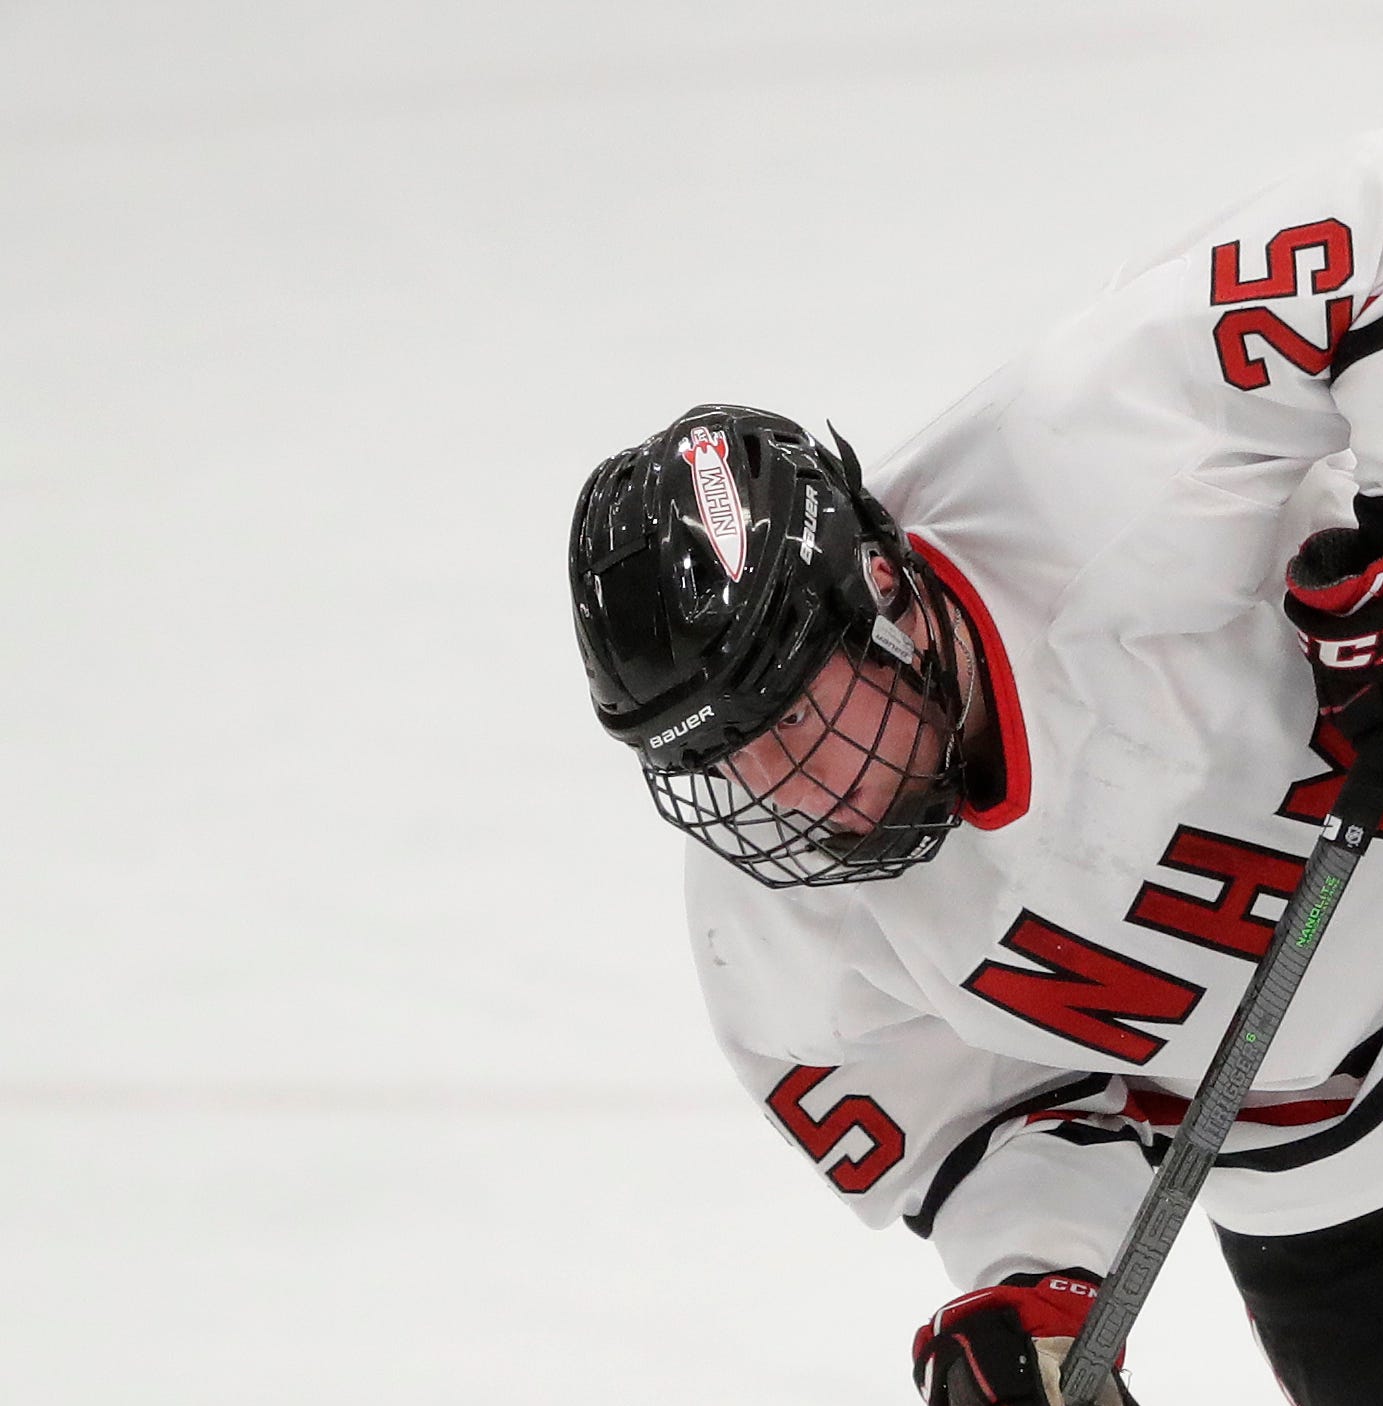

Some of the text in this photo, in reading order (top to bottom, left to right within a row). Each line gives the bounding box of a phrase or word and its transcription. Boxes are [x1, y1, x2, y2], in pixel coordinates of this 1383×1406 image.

[1210, 217, 1355, 392] 25
[698, 466, 738, 538] NHM
[800, 484, 819, 566] BAUER
[649, 704, 716, 750] BAUER
[1294, 875, 1338, 948] NANOLITE
[765, 1064, 906, 1194] 5
